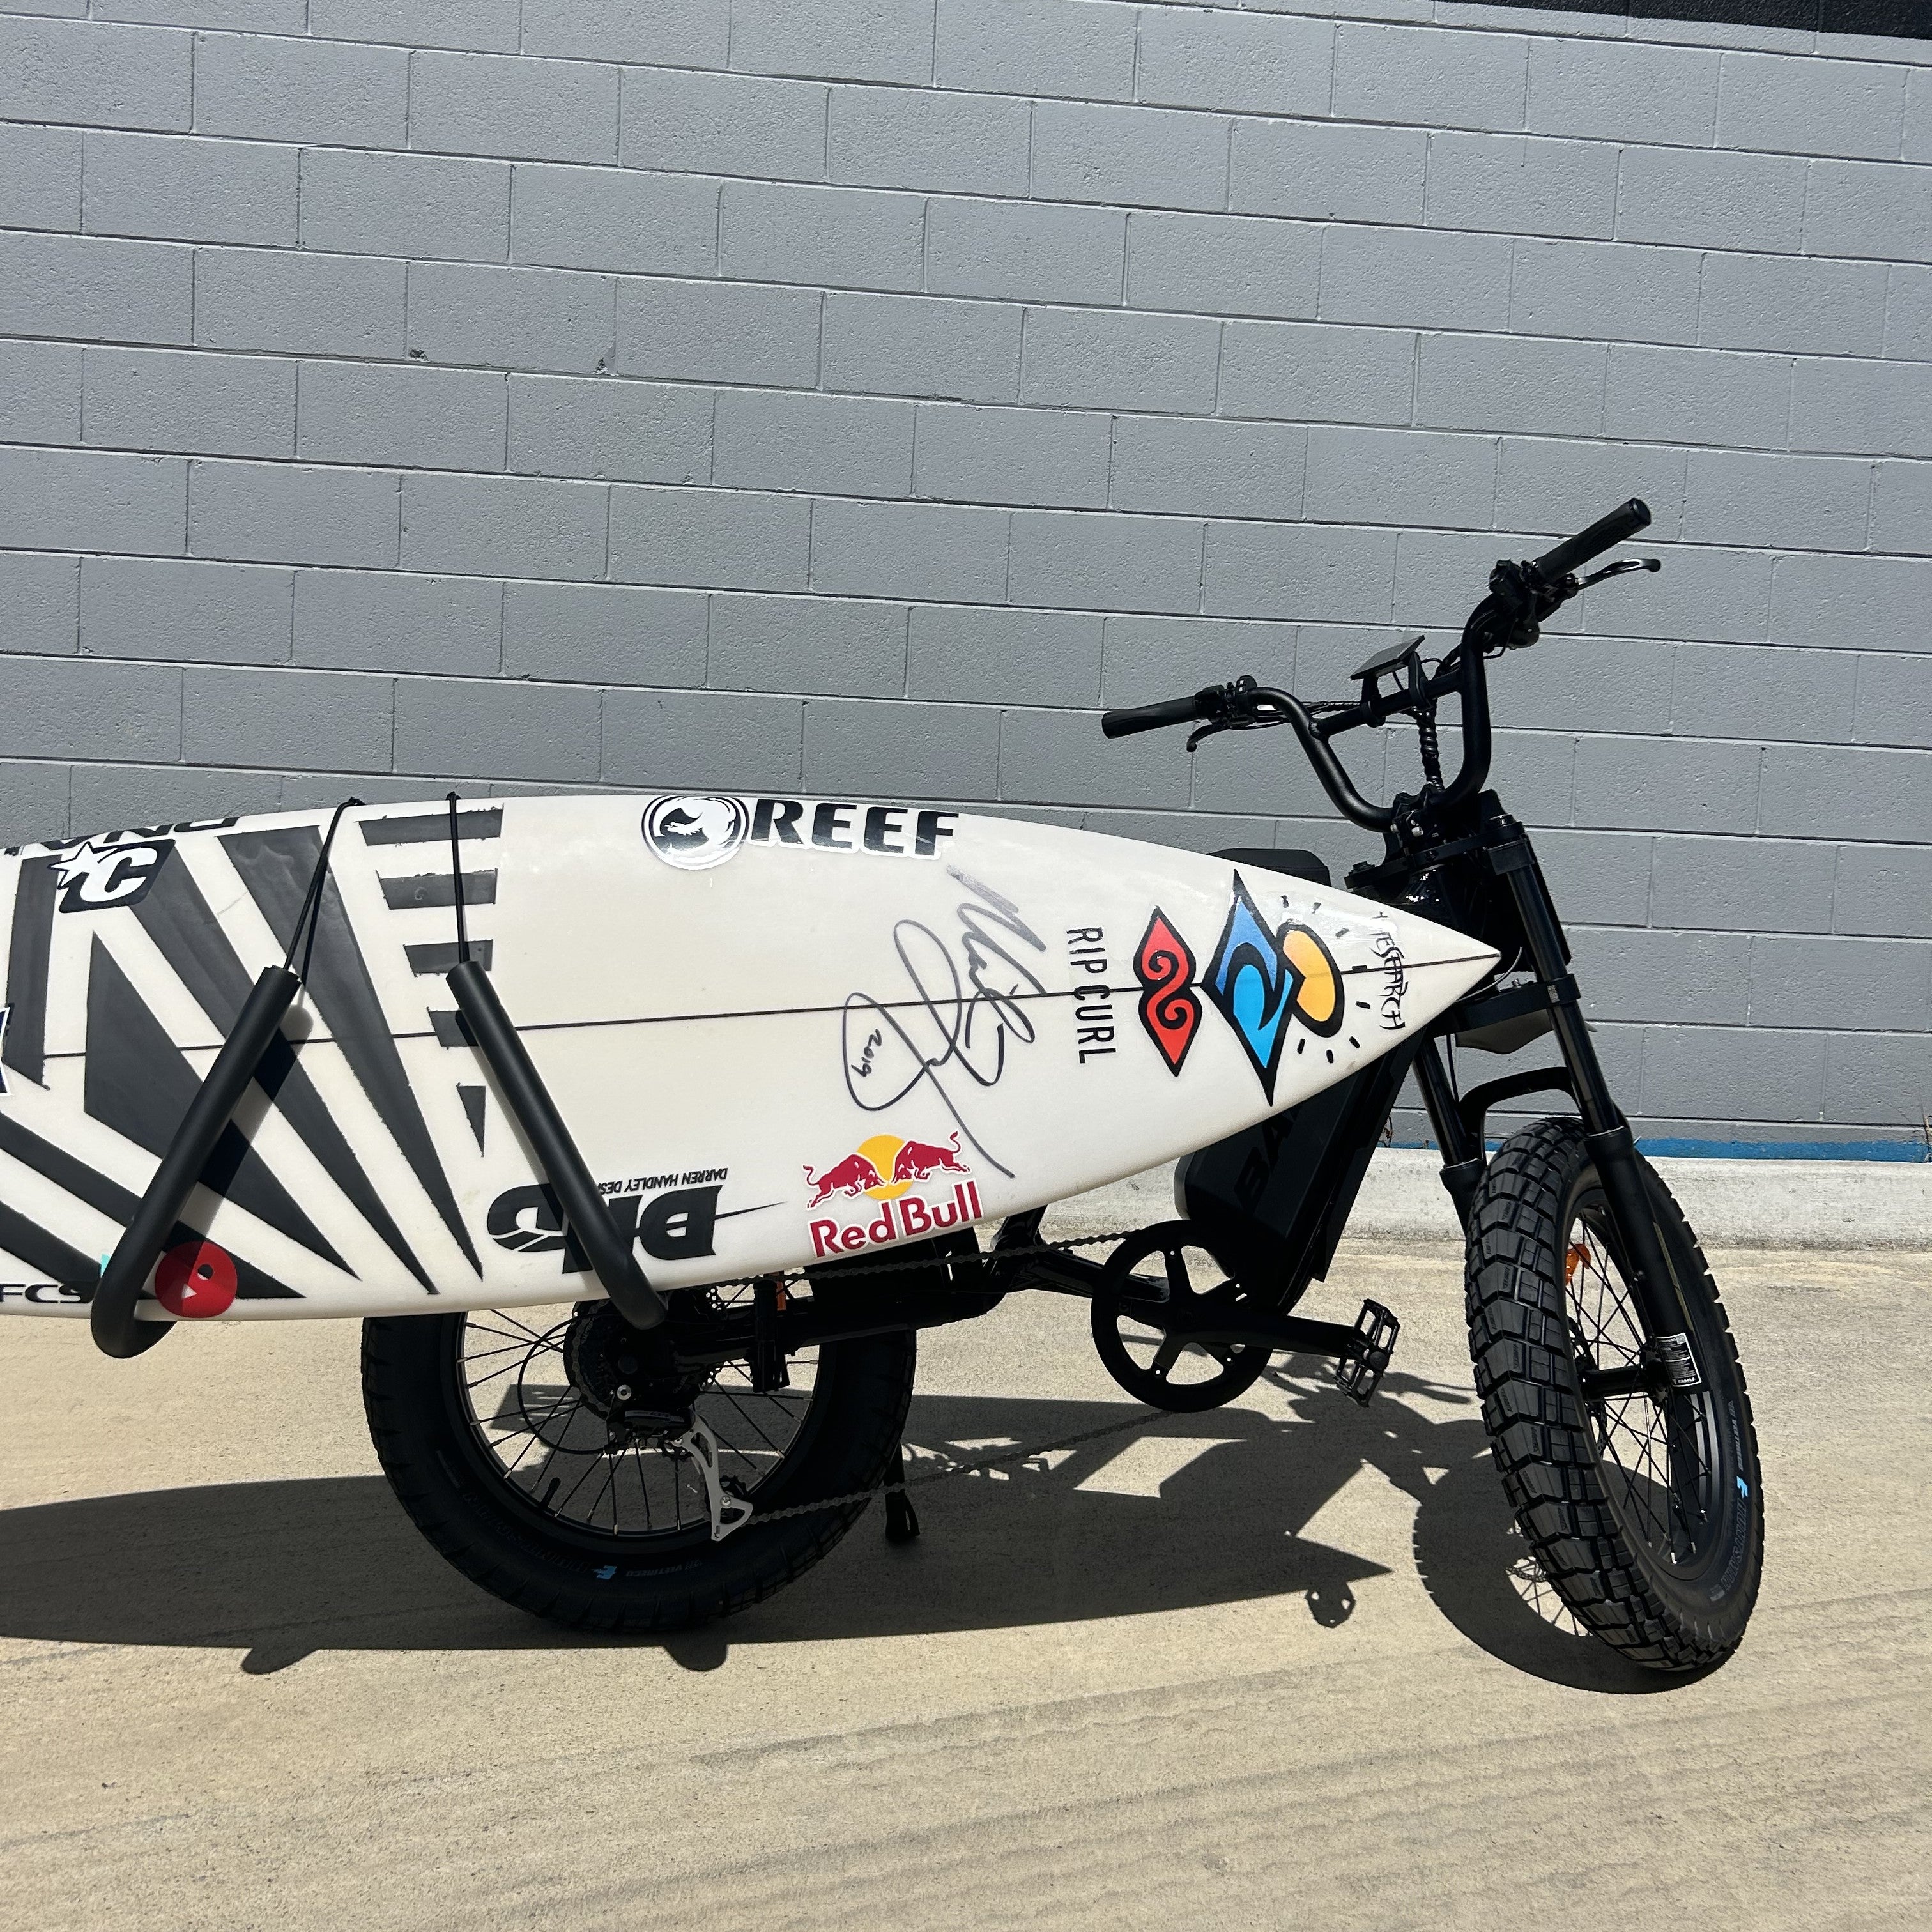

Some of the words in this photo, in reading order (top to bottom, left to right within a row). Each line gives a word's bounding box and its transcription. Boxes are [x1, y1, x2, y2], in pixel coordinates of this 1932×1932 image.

[750, 799, 960, 857] REEF
[1066, 927, 1107, 976] RIP
[1073, 985, 1117, 1064] CURL
[851, 1029, 883, 1078] 2019
[624, 1172, 679, 1193] HANDLEY
[680, 1167, 728, 1186] DARREN
[810, 1200, 894, 1259] Red
[897, 1181, 983, 1236] Bull
